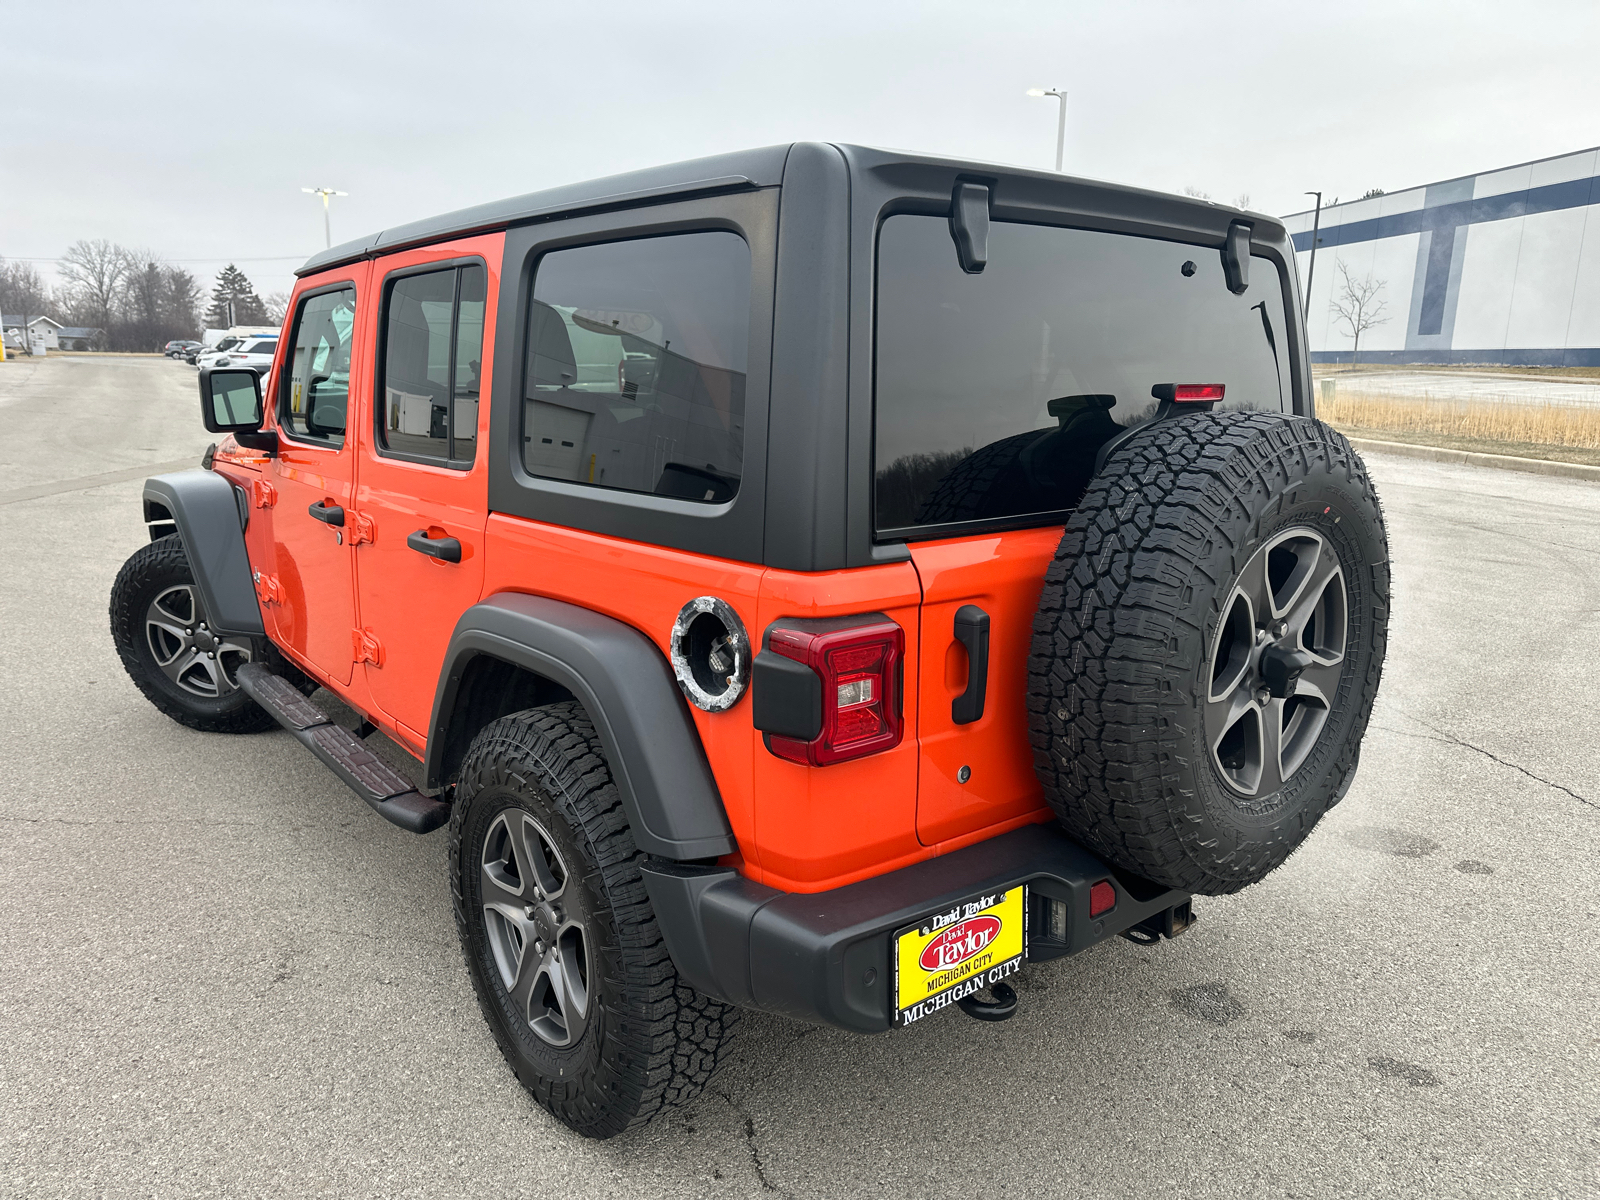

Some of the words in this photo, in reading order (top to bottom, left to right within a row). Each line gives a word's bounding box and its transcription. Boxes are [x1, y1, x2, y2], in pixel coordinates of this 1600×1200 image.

[932, 906, 960, 931] David
[963, 894, 996, 917] Taylor
[933, 926, 993, 968] Taylor
[942, 924, 965, 944] David
[903, 974, 985, 1026] MICHIGAN
[988, 956, 1022, 984] CITY
[927, 962, 971, 993] MICHIGAN
[974, 951, 994, 971] CITY
